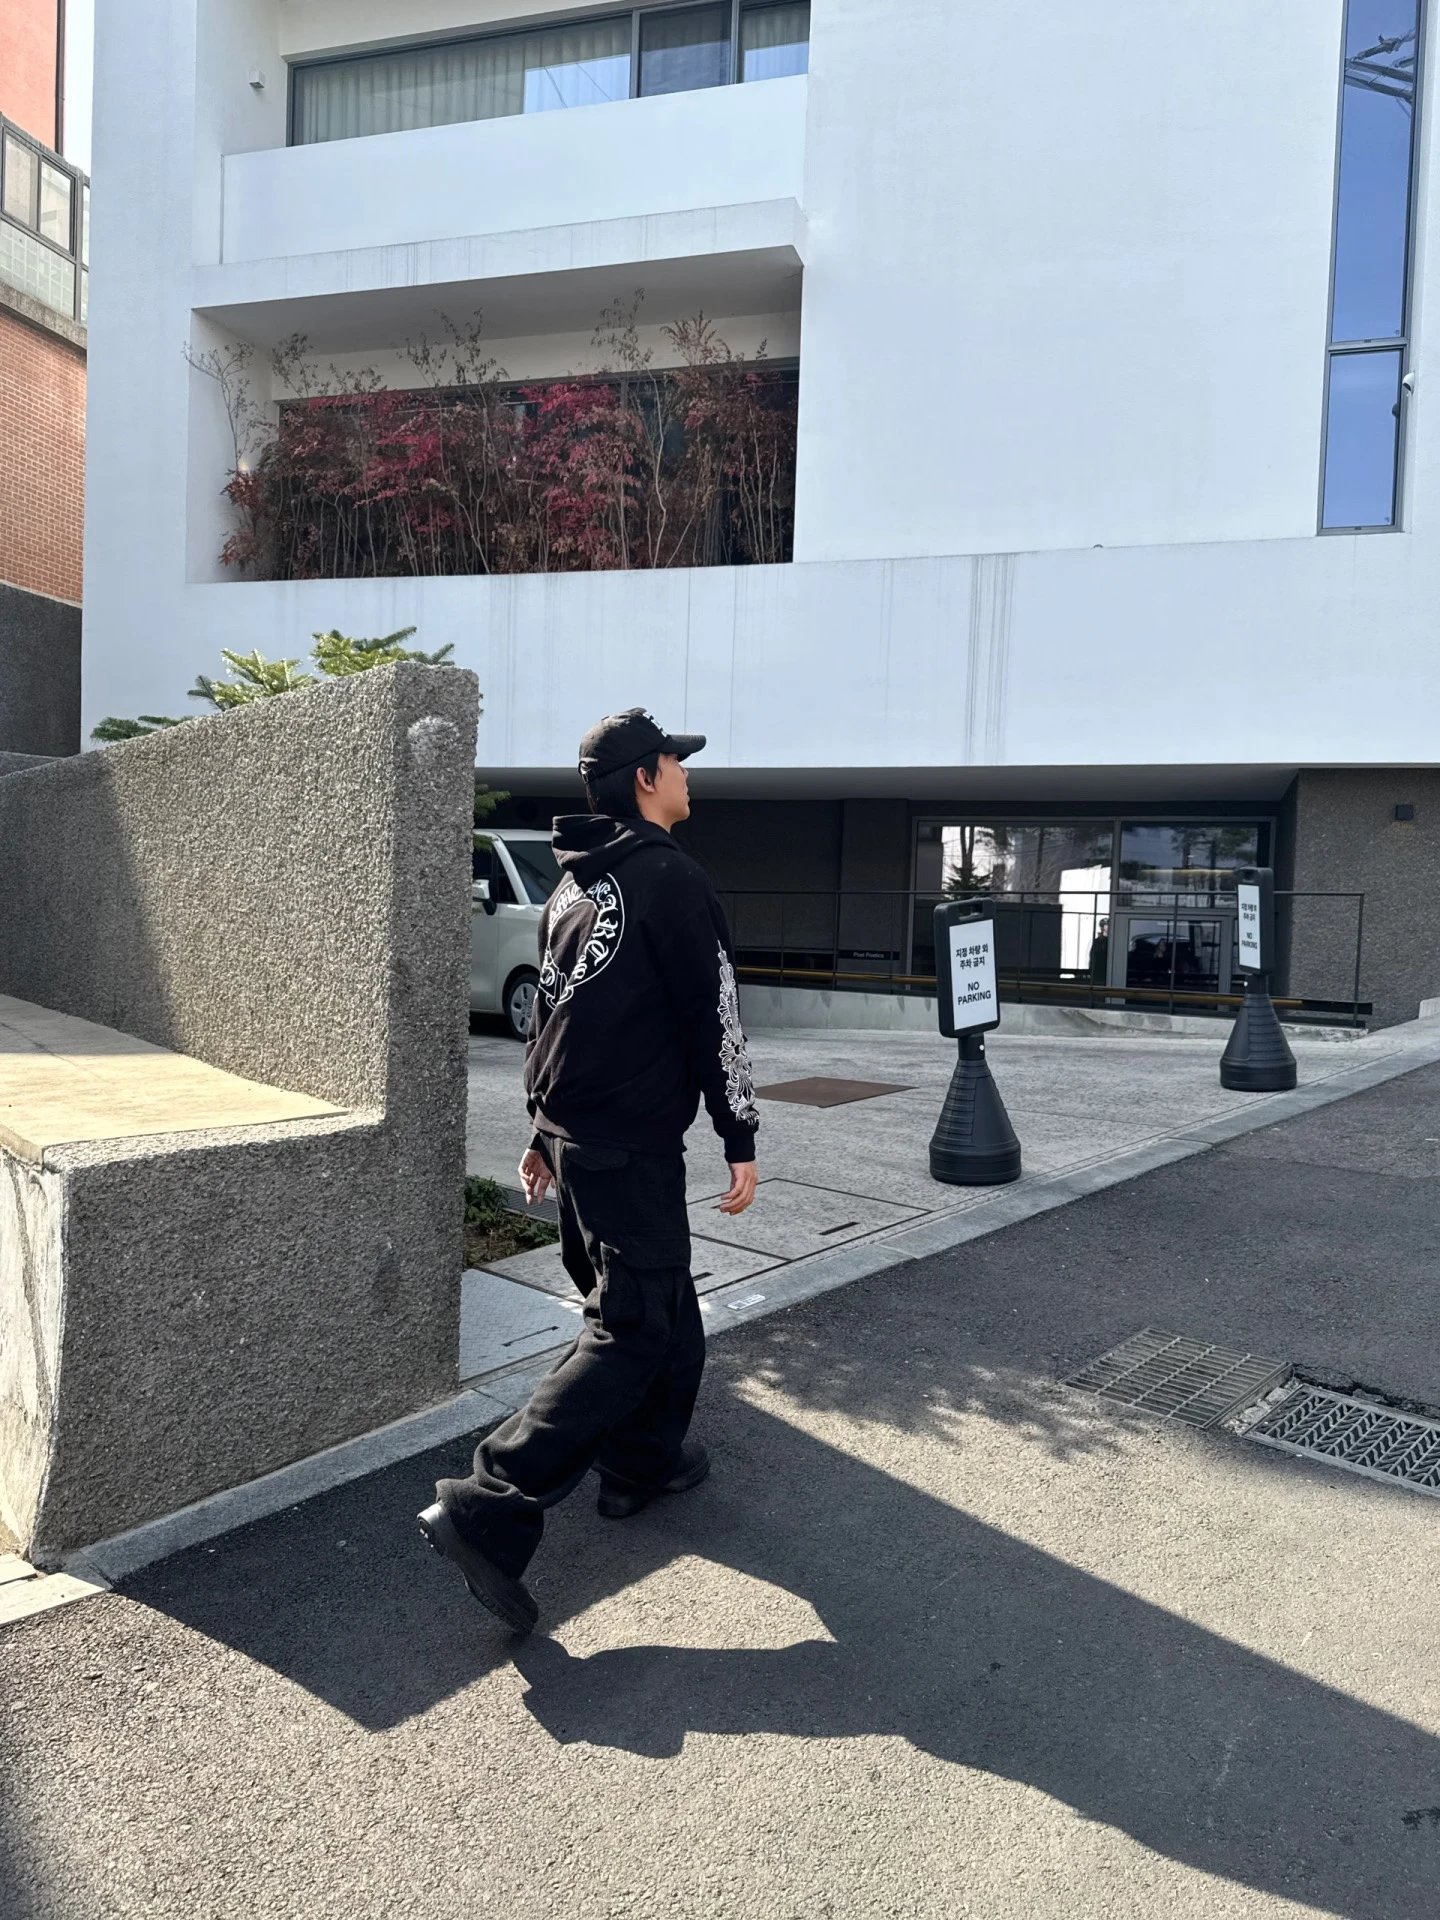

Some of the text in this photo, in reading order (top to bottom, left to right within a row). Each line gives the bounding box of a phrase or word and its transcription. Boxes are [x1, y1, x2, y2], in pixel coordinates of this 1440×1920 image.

[956, 943, 989, 958] 지정 차량 외
[960, 956, 985, 970] 주차 금지
[967, 981, 980, 991] NO
[957, 990, 992, 1005] PARKING
